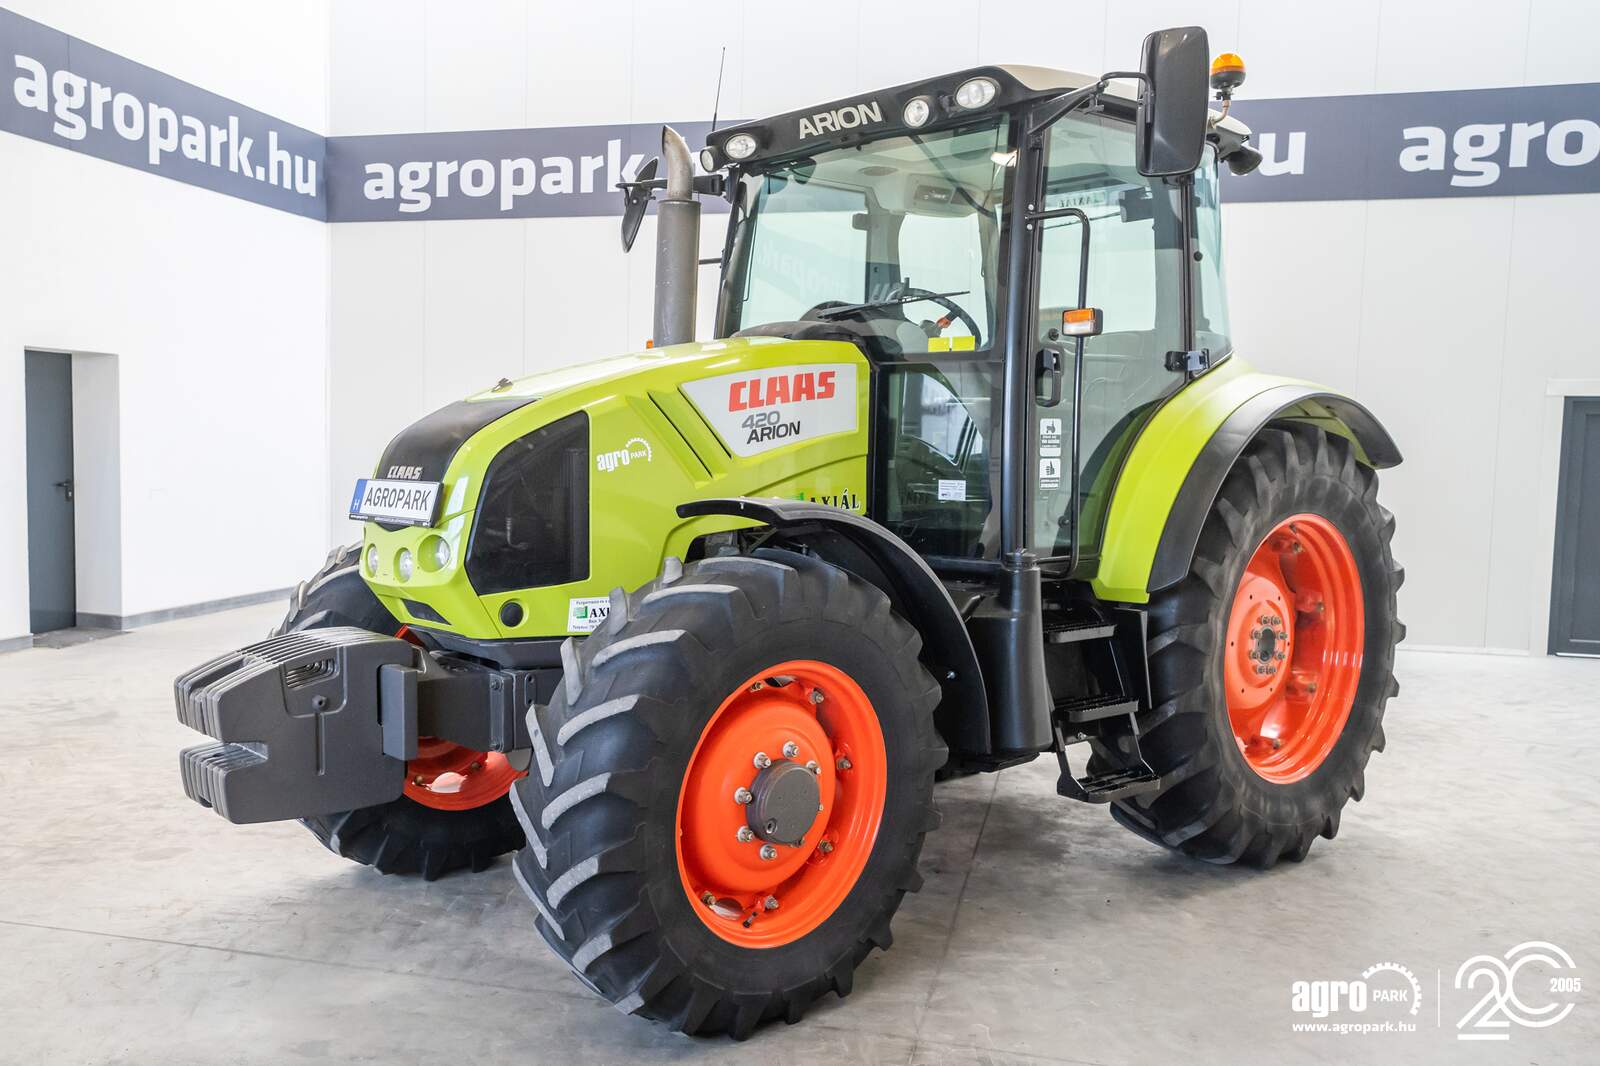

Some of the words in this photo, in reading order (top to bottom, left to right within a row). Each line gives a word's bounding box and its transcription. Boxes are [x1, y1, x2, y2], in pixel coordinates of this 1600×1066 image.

[13, 53, 317, 198] agropark.hu
[799, 101, 883, 139] ARION
[363, 139, 708, 213] agropark
[728, 370, 836, 412] CLAAS
[741, 410, 781, 429] 420
[746, 420, 801, 445] ARION
[386, 465, 423, 480] CLAAS
[596, 448, 630, 472] agro
[630, 449, 648, 461] PARK
[353, 499, 360, 511] H
[364, 487, 432, 511] AGROPARK
